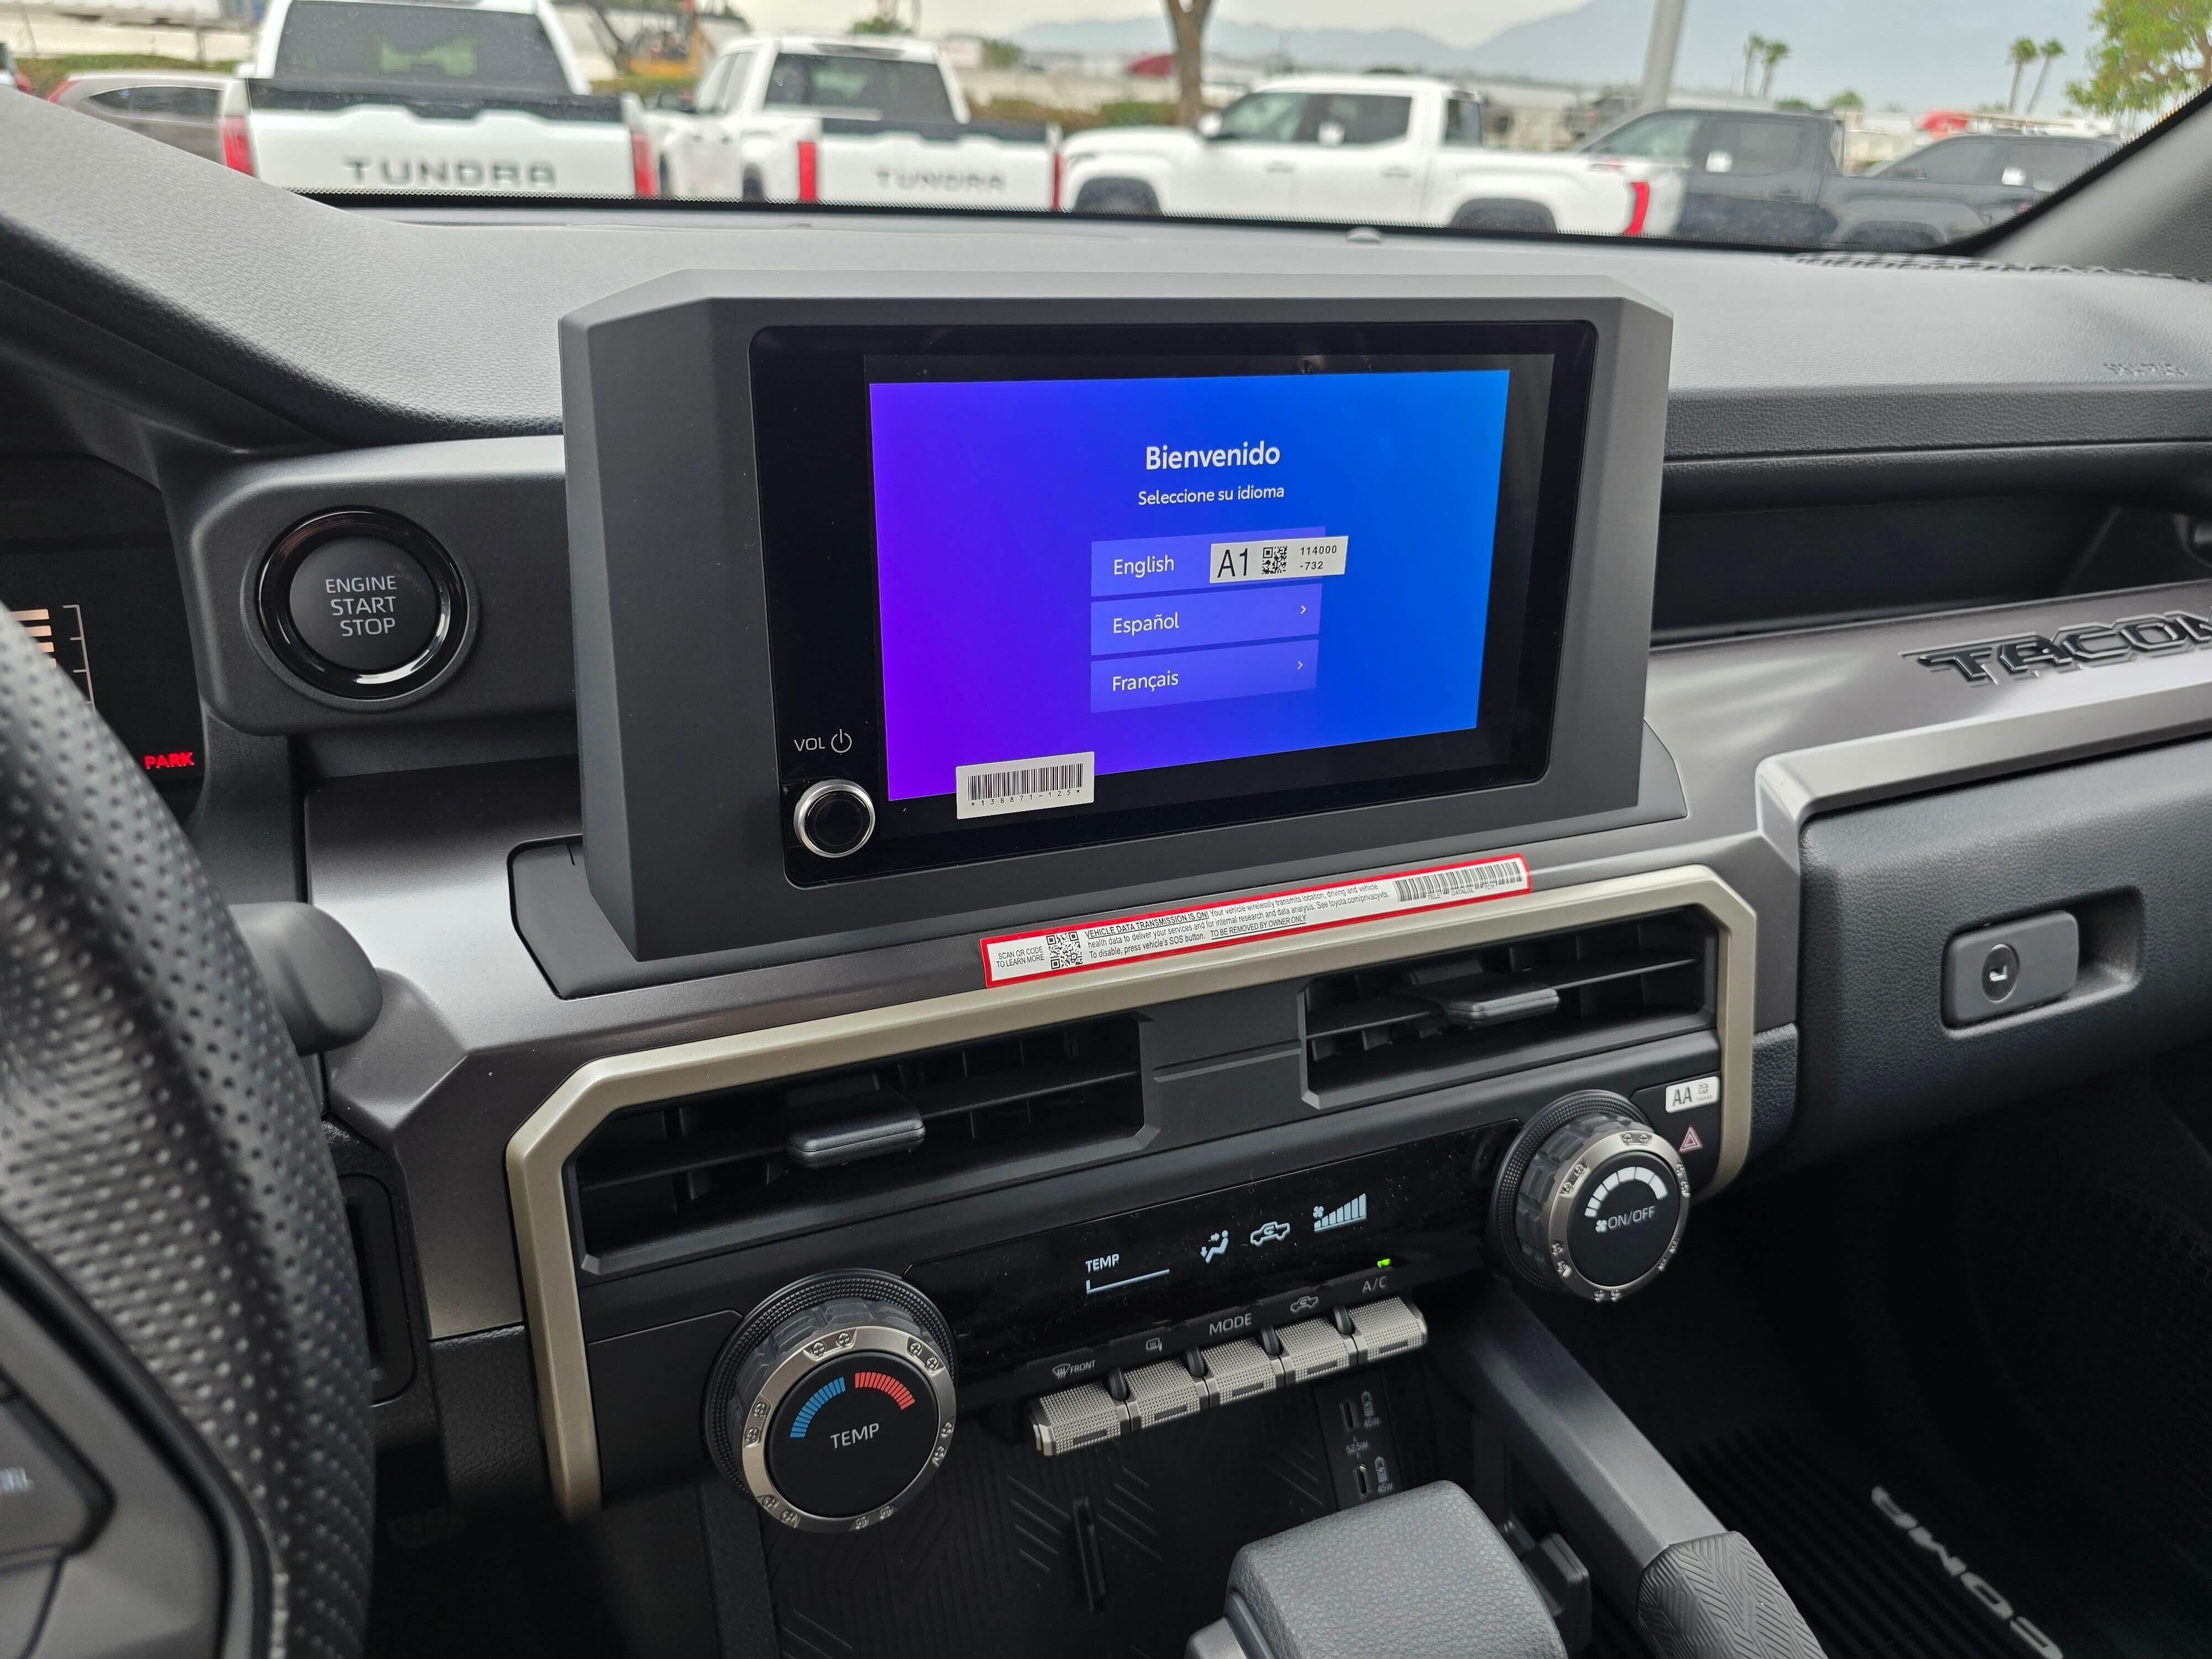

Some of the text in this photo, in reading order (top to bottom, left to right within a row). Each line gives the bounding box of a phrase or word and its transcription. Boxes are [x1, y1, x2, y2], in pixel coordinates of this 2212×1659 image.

[342, 156, 558, 186] TUNDRA
[874, 169, 1006, 194] TUNDRA
[1146, 440, 1281, 470] Bienvenido
[1138, 484, 1285, 505] Seleccione su idioma
[1300, 545, 1337, 556] 114000
[1113, 555, 1175, 578] English
[1217, 547, 1249, 578] A1
[1300, 561, 1323, 570] -732
[325, 576, 398, 593] ENGINE
[331, 596, 397, 616] START
[340, 617, 395, 637] STOP
[1113, 612, 1180, 636] Español
[1112, 670, 1179, 692] Français
[794, 737, 826, 752] VOL
[144, 751, 195, 770] PARK
[1084, 926, 1115, 938] VEHICLE
[1116, 924, 1135, 933] DATA
[1136, 914, 1188, 929] TRANSMISSION
[1225, 905, 1245, 914] vehicle
[1246, 900, 1274, 911] wirelessly
[1275, 896, 1302, 906] transmits
[1302, 892, 1327, 901] location,
[1327, 889, 1346, 898] driving
[1358, 883, 1378, 892] vehicle
[1088, 938, 1107, 949] health
[1108, 936, 1123, 946] data
[1132, 931, 1151, 941] deliver
[1153, 929, 1166, 939] your
[1168, 925, 1193, 935] services
[1194, 921, 1205, 930] and
[1206, 919, 1214, 928] for
[1215, 915, 1237, 926] internal
[1239, 911, 1264, 922] research
[1264, 909, 1276, 917] and
[1278, 907, 1290, 916] data
[1291, 904, 1316, 914] analysis.
[1089, 951, 1097, 959] To
[1099, 946, 1123, 958] disable,
[1124, 944, 1141, 955] press
[1142, 939, 1168, 950] vehicle's
[1170, 935, 1183, 945] SOS
[1185, 933, 1206, 942] button.
[1220, 927, 1228, 936] BE
[1229, 922, 1259, 933] REMOVED
[1260, 921, 1268, 929] BY
[1269, 917, 1290, 927] OWNER
[1291, 914, 1306, 923] ONLY
[998, 951, 1015, 960] SCAN
[1026, 946, 1044, 955] CODE
[1006, 957, 1025, 967] LEARN
[1027, 953, 1045, 963] MORE
[1672, 1086, 1692, 1107] AA
[1608, 1206, 1655, 1229] ON/OFF
[1086, 1253, 1120, 1274] TEMP
[1361, 1275, 1387, 1293] A/C
[1209, 1313, 1252, 1337] MODE
[1070, 1359, 1096, 1374] FRONT
[830, 1422, 879, 1449] TEMP
